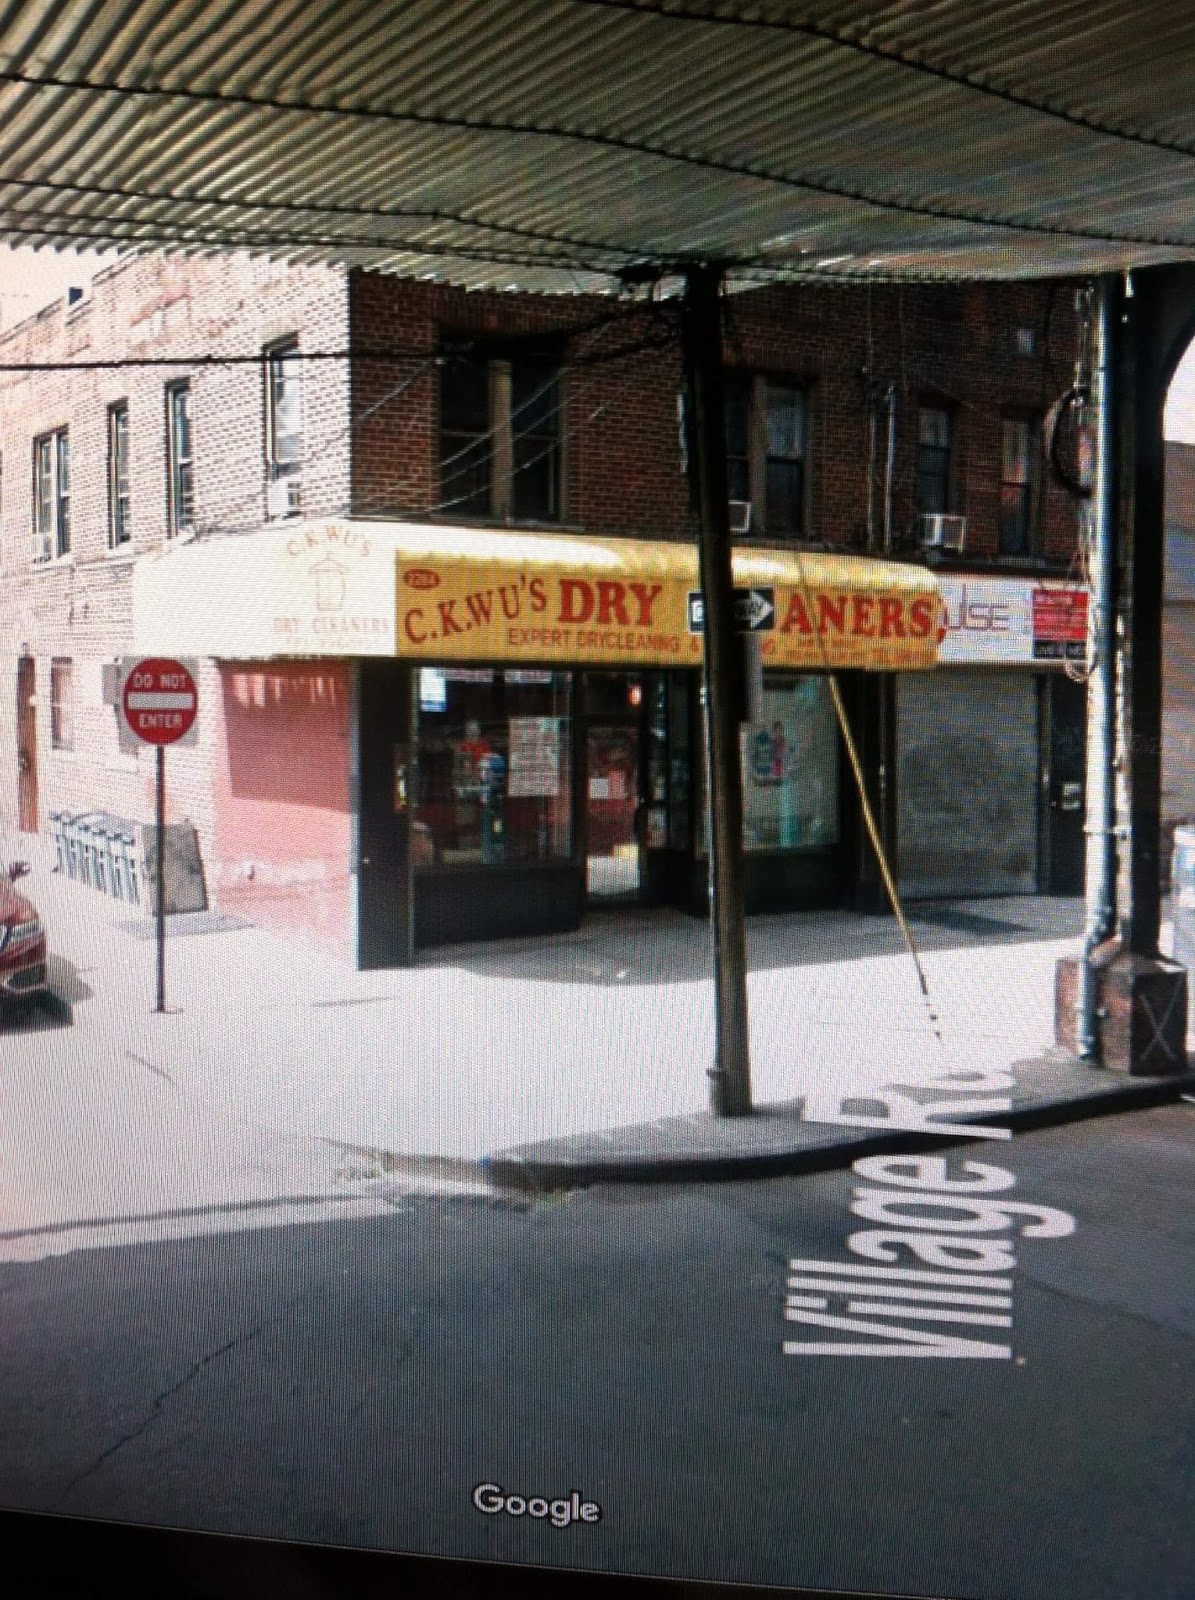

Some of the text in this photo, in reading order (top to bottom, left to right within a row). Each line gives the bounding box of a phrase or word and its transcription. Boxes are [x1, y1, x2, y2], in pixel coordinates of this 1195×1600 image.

[557, 578, 663, 627] DRY
[508, 628, 571, 648] EXPERT
[133, 673, 187, 689] DO NOT
[139, 713, 183, 729] ENTER
